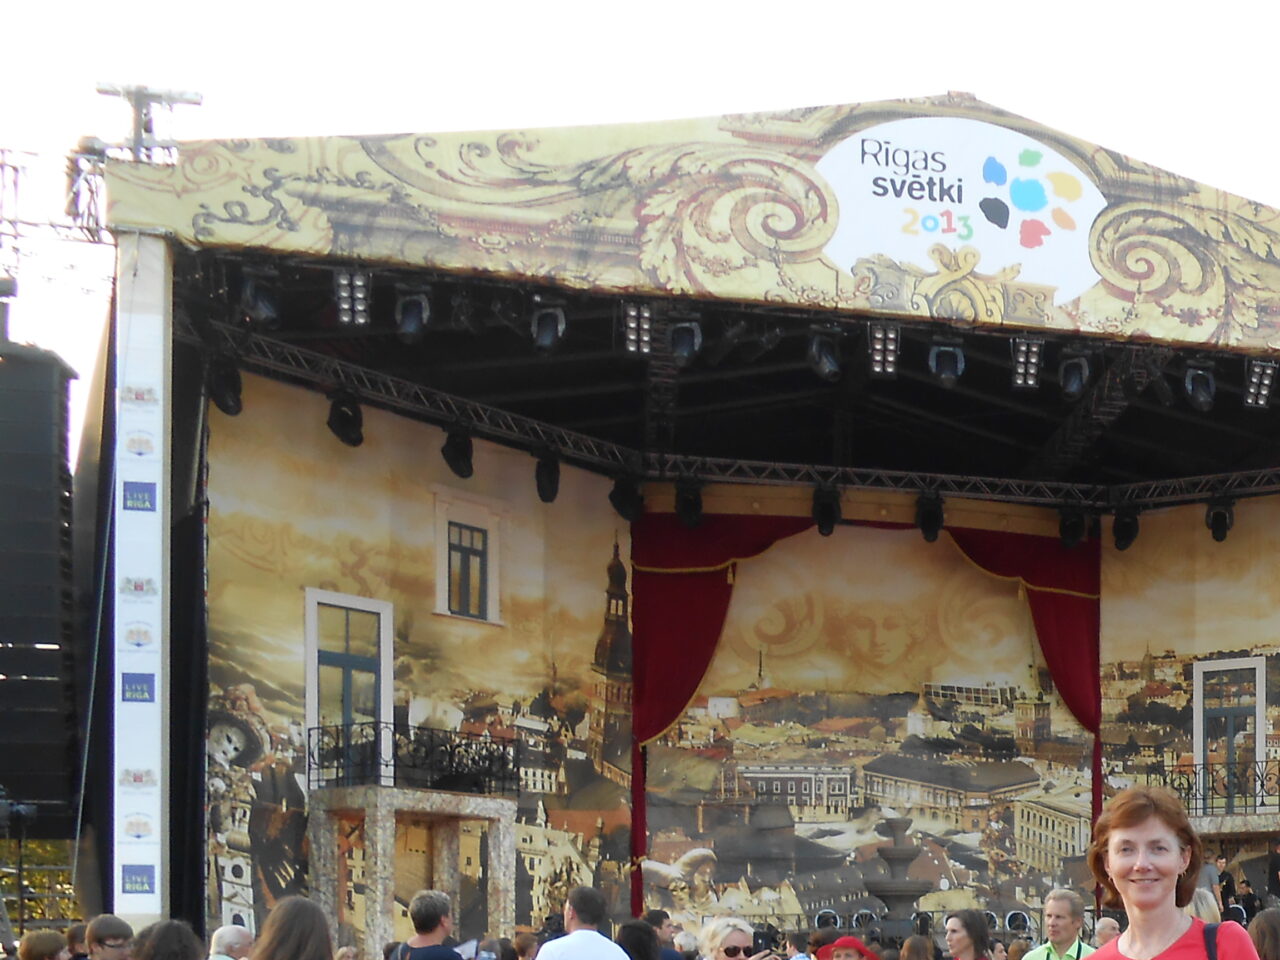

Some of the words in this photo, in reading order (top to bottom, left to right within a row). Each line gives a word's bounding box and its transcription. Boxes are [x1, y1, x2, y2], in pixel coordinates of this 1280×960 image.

[861, 138, 947, 176] Rīgas
[872, 174, 963, 204] svētki
[902, 208, 974, 241] 2013
[127, 492, 151, 500] LIVE
